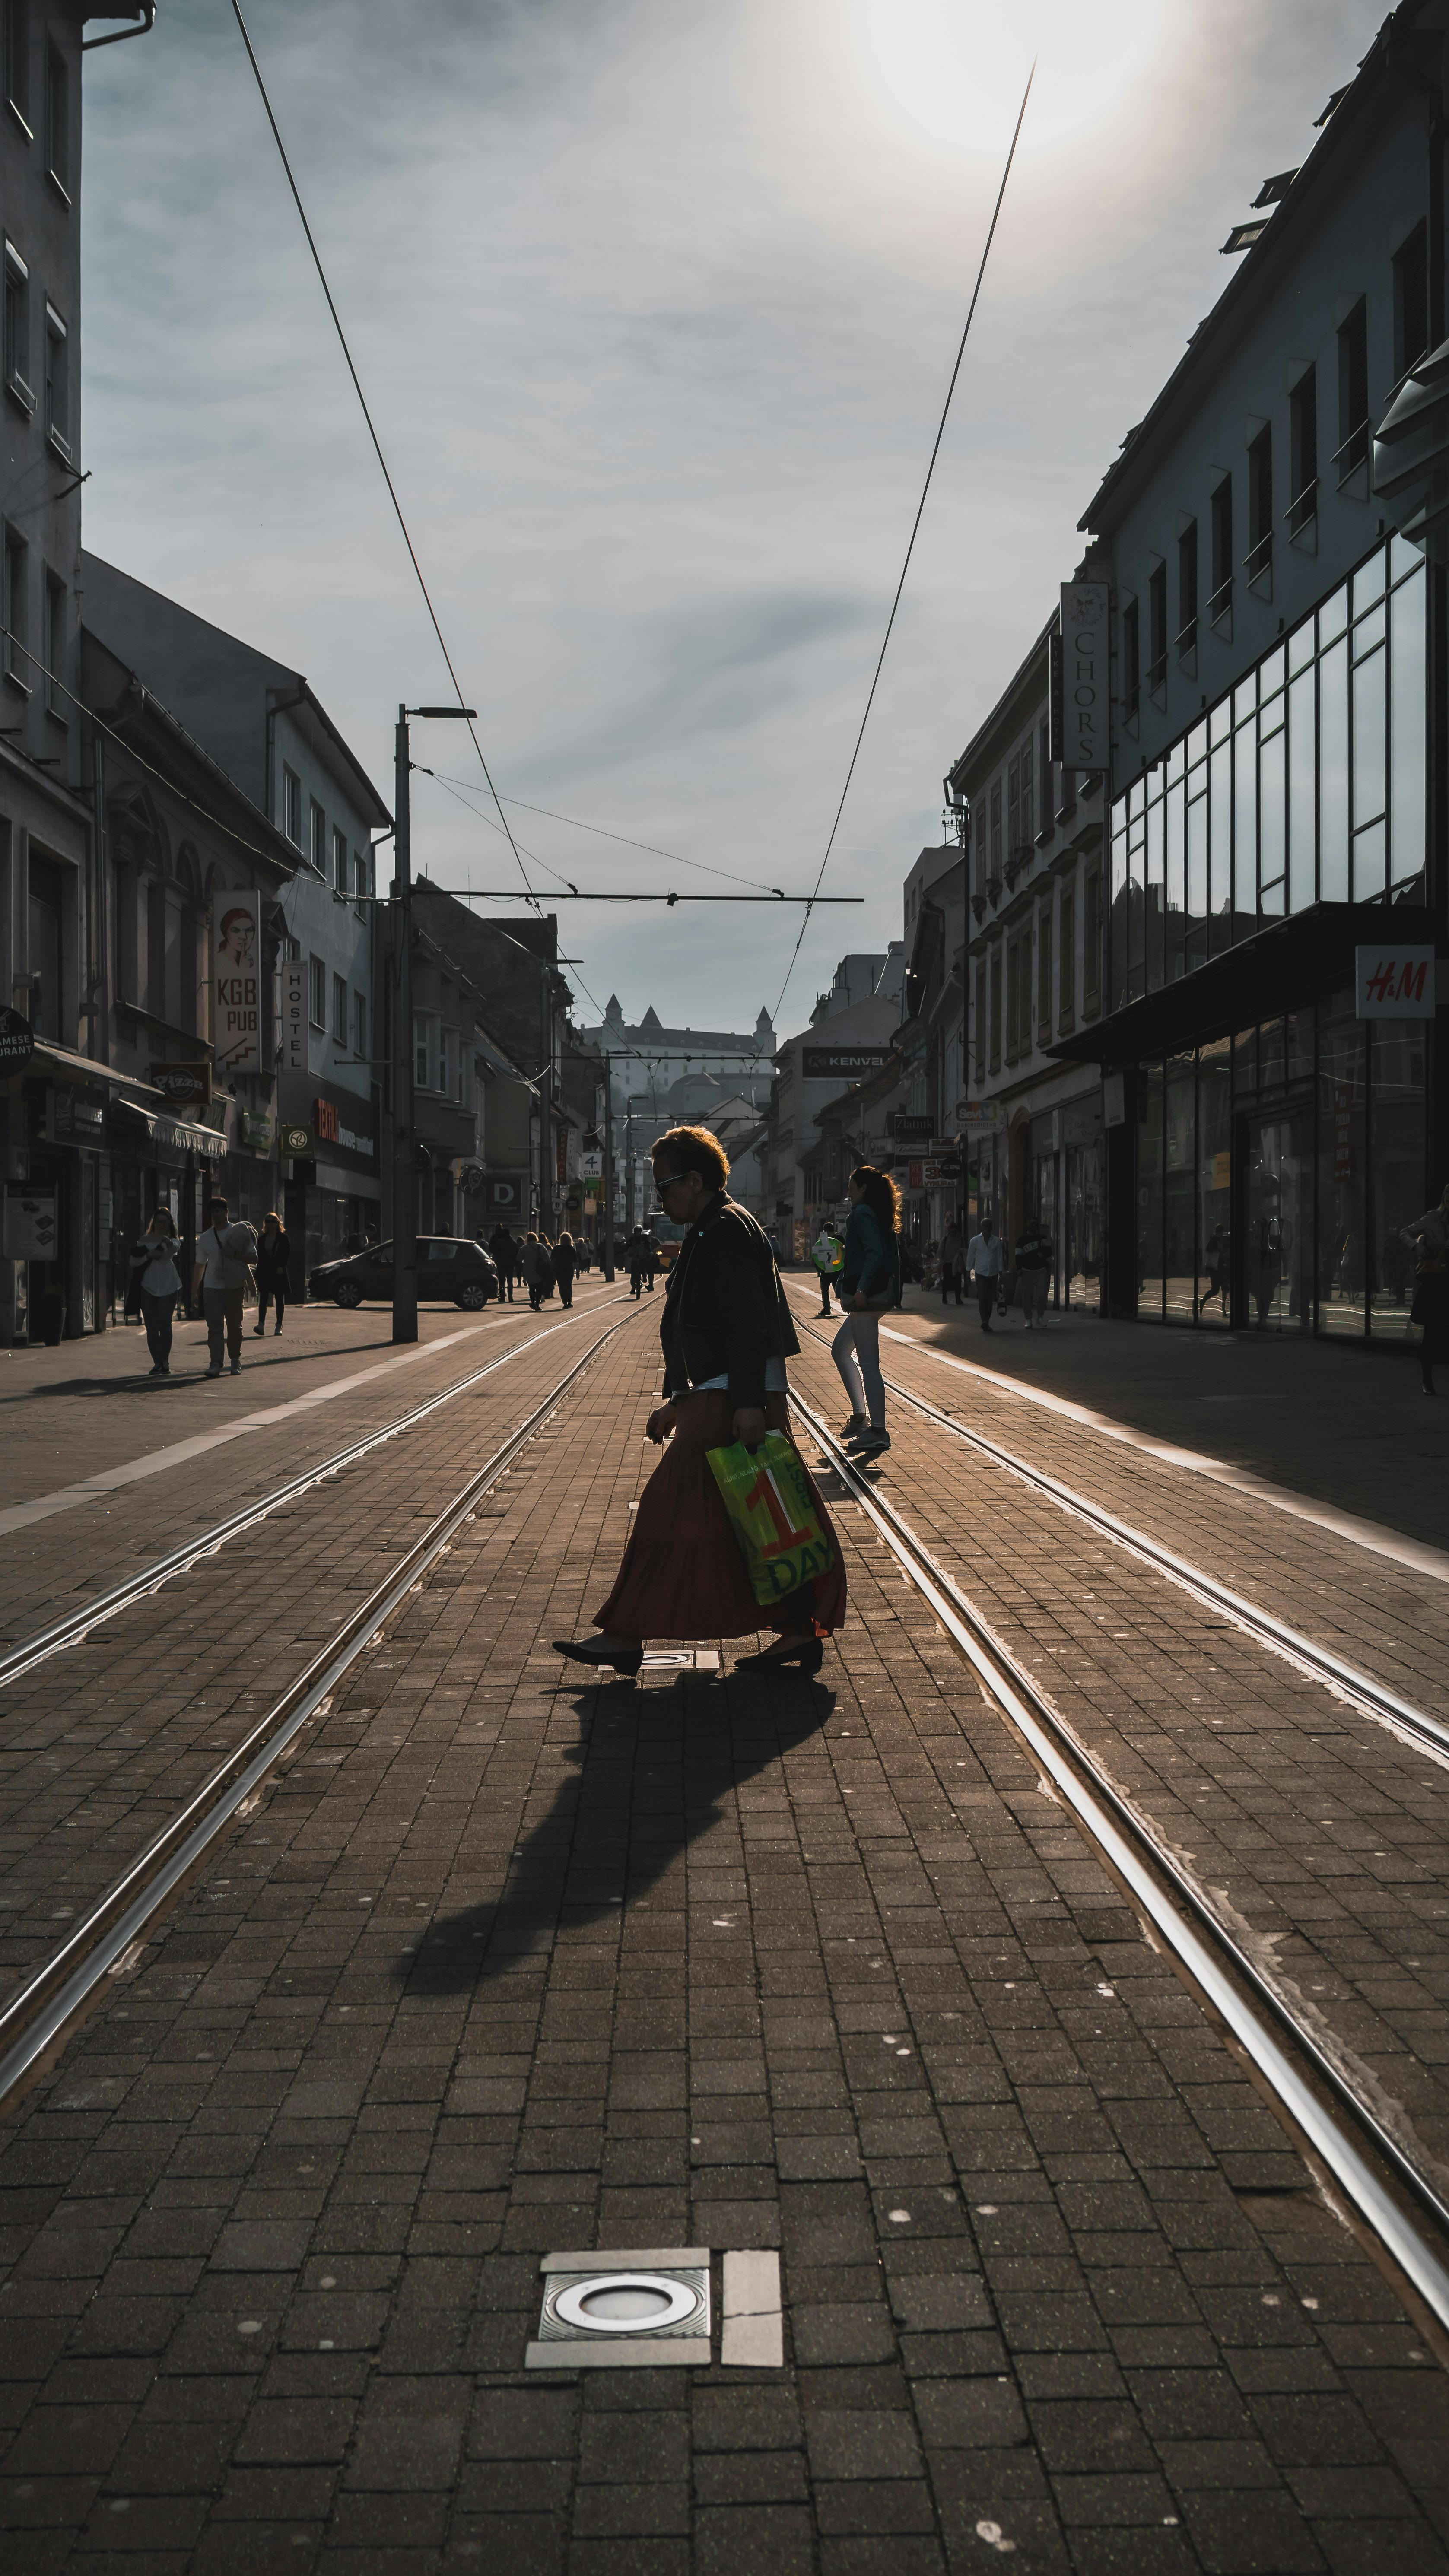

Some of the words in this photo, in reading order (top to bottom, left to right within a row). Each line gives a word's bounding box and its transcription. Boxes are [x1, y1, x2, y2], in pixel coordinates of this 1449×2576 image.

[1074, 632, 1099, 761] CHORS
[218, 978, 257, 1006] KGB
[1366, 961, 1428, 1003] H&M
[228, 1011, 257, 1032] PUB
[289, 975, 301, 1067] HOSTEL
[0, 1035, 30, 1045] MESE
[153, 1076, 203, 1090] Pizza
[585, 1156, 598, 1169] 4
[494, 1184, 514, 1204] D
[766, 1541, 832, 1595] DAY
